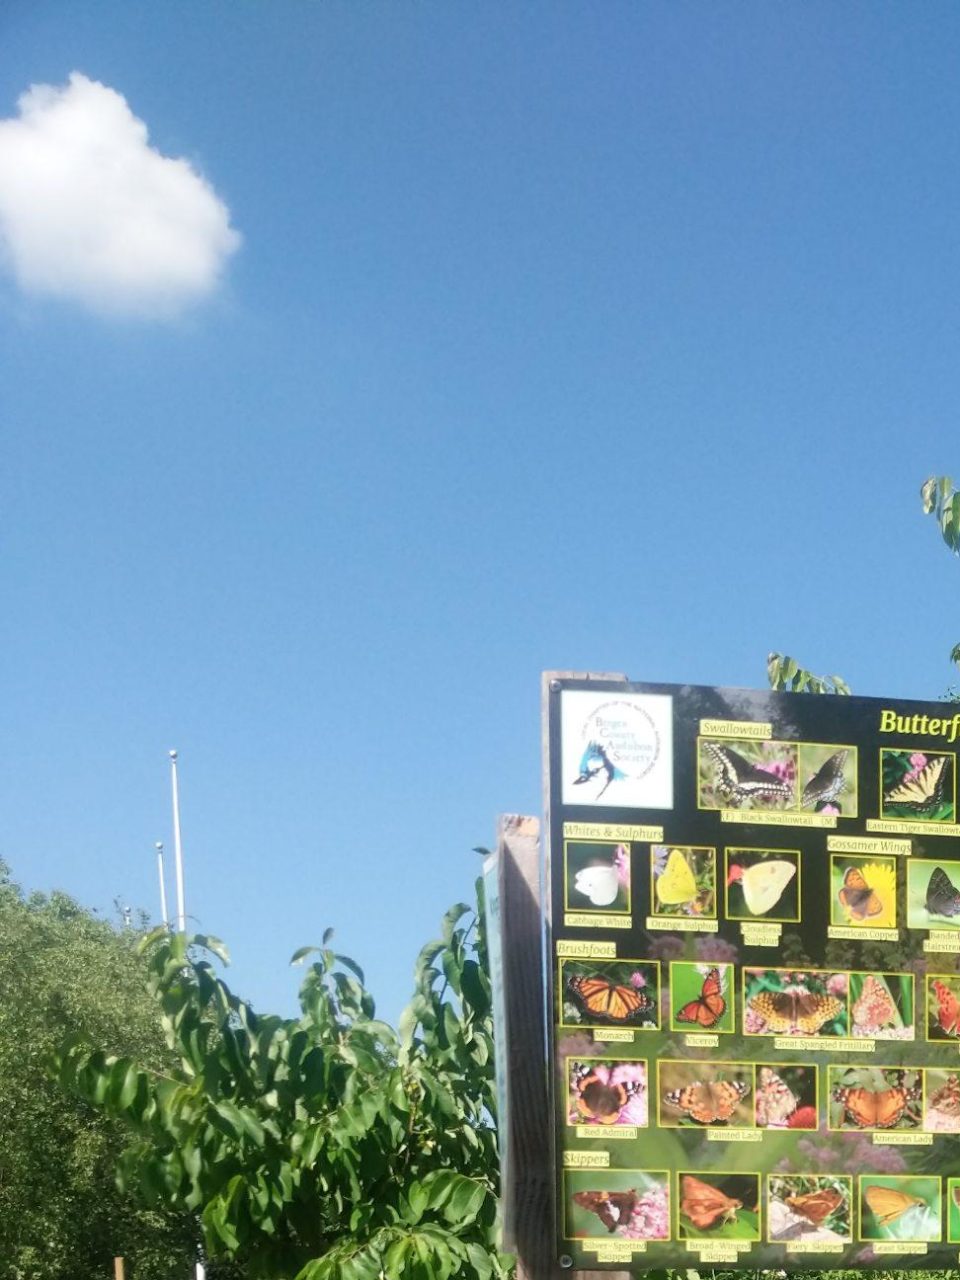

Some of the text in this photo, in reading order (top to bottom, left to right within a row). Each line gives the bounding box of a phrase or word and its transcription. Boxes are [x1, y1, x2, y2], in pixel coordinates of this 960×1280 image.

[703, 722, 772, 737] Swallowtails
[740, 813, 762, 824] Black
[763, 814, 813, 826] Swallowtail
[564, 825, 663, 841] Whites & Sulphurs
[867, 821, 896, 832] Eastern
[899, 823, 920, 835] Tiger
[828, 839, 911, 855] Gossamer Wings
[567, 917, 631, 928] Cabbage White
[651, 920, 717, 932] Orange Sulphur
[741, 924, 781, 934] Cloudless
[829, 928, 898, 940] American Copper
[744, 934, 779, 945] Sulphur
[930, 931, 960, 940] Banded
[558, 943, 616, 957] Brushfoots
[594, 1031, 634, 1041] Monarch
[775, 1039, 875, 1052] Great Spangled Fritillary
[584, 1128, 637, 1138] Red Admiral
[708, 1130, 762, 1141] Painted Lady
[873, 1134, 932, 1145] American Lady
[564, 1152, 610, 1166] Skippers
[707, 1252, 737, 1263] Skipper
